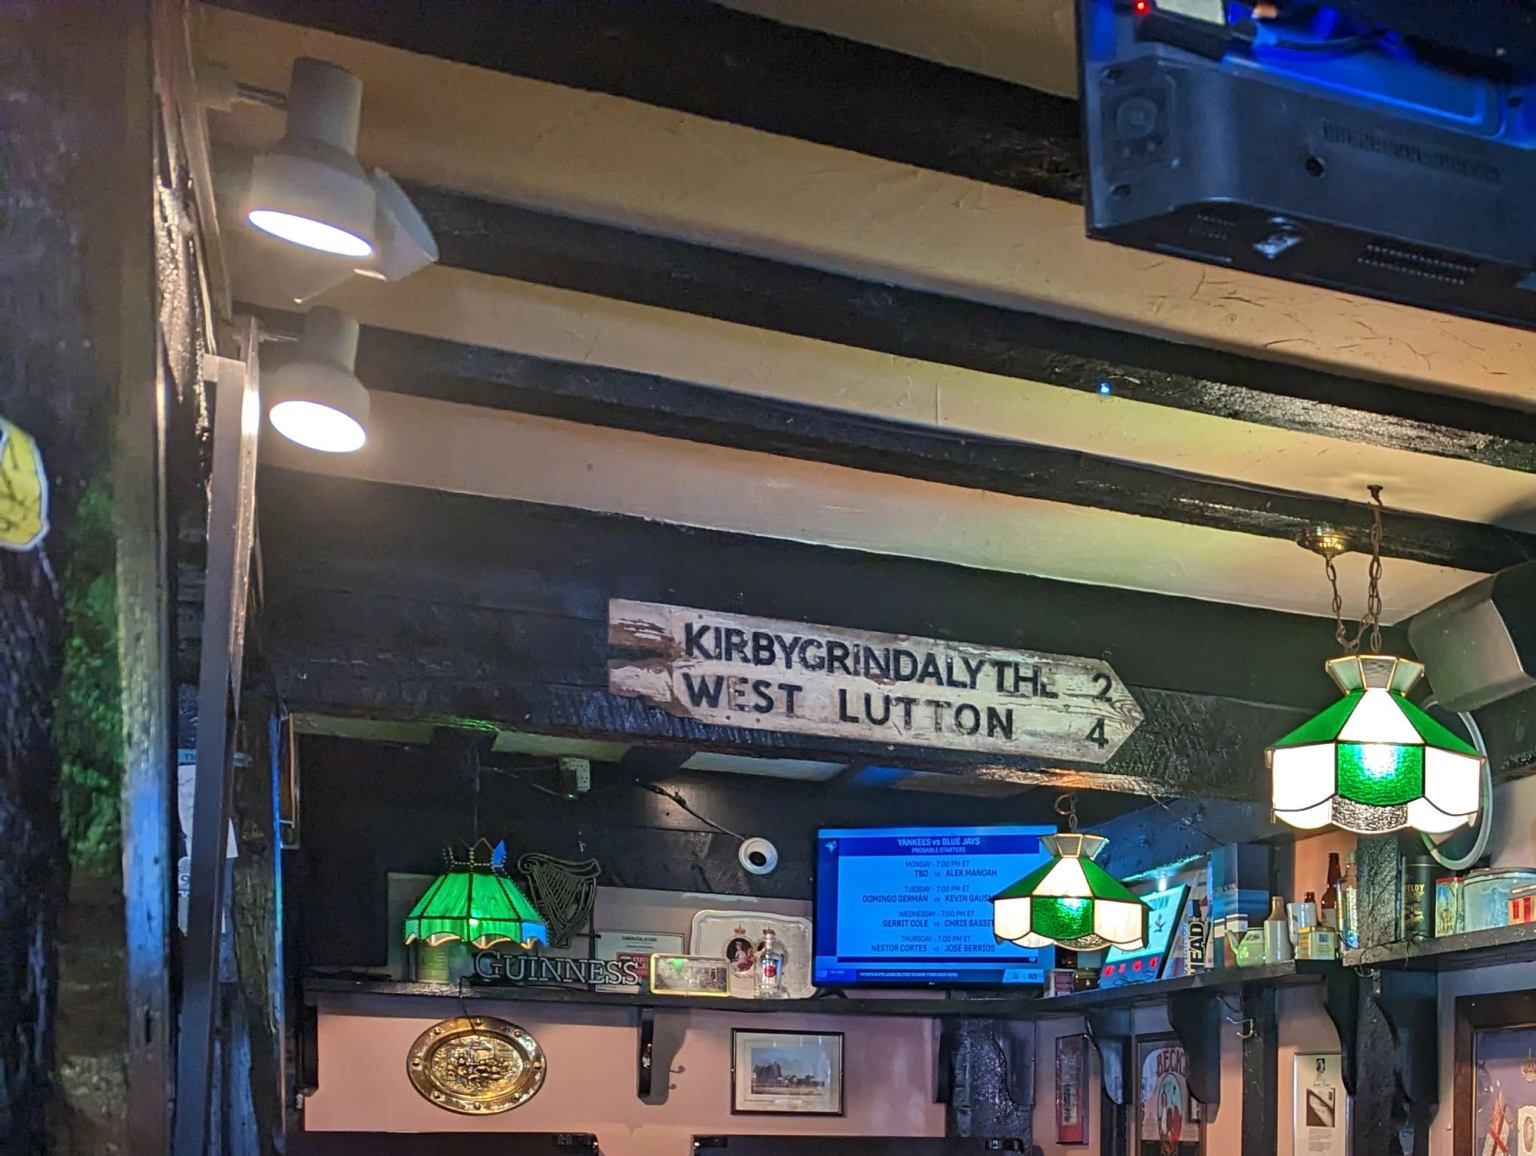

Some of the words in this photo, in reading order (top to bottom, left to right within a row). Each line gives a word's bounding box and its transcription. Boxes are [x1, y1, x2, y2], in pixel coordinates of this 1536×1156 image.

[1092, 673, 1113, 702] 2
[681, 673, 802, 716] WEST
[839, 687, 1014, 740] LUTTON
[1086, 717, 1109, 749] 4
[897, 839, 932, 847] YANKEES
[942, 838, 961, 846] BLUE
[474, 950, 641, 985] GUINNESS
